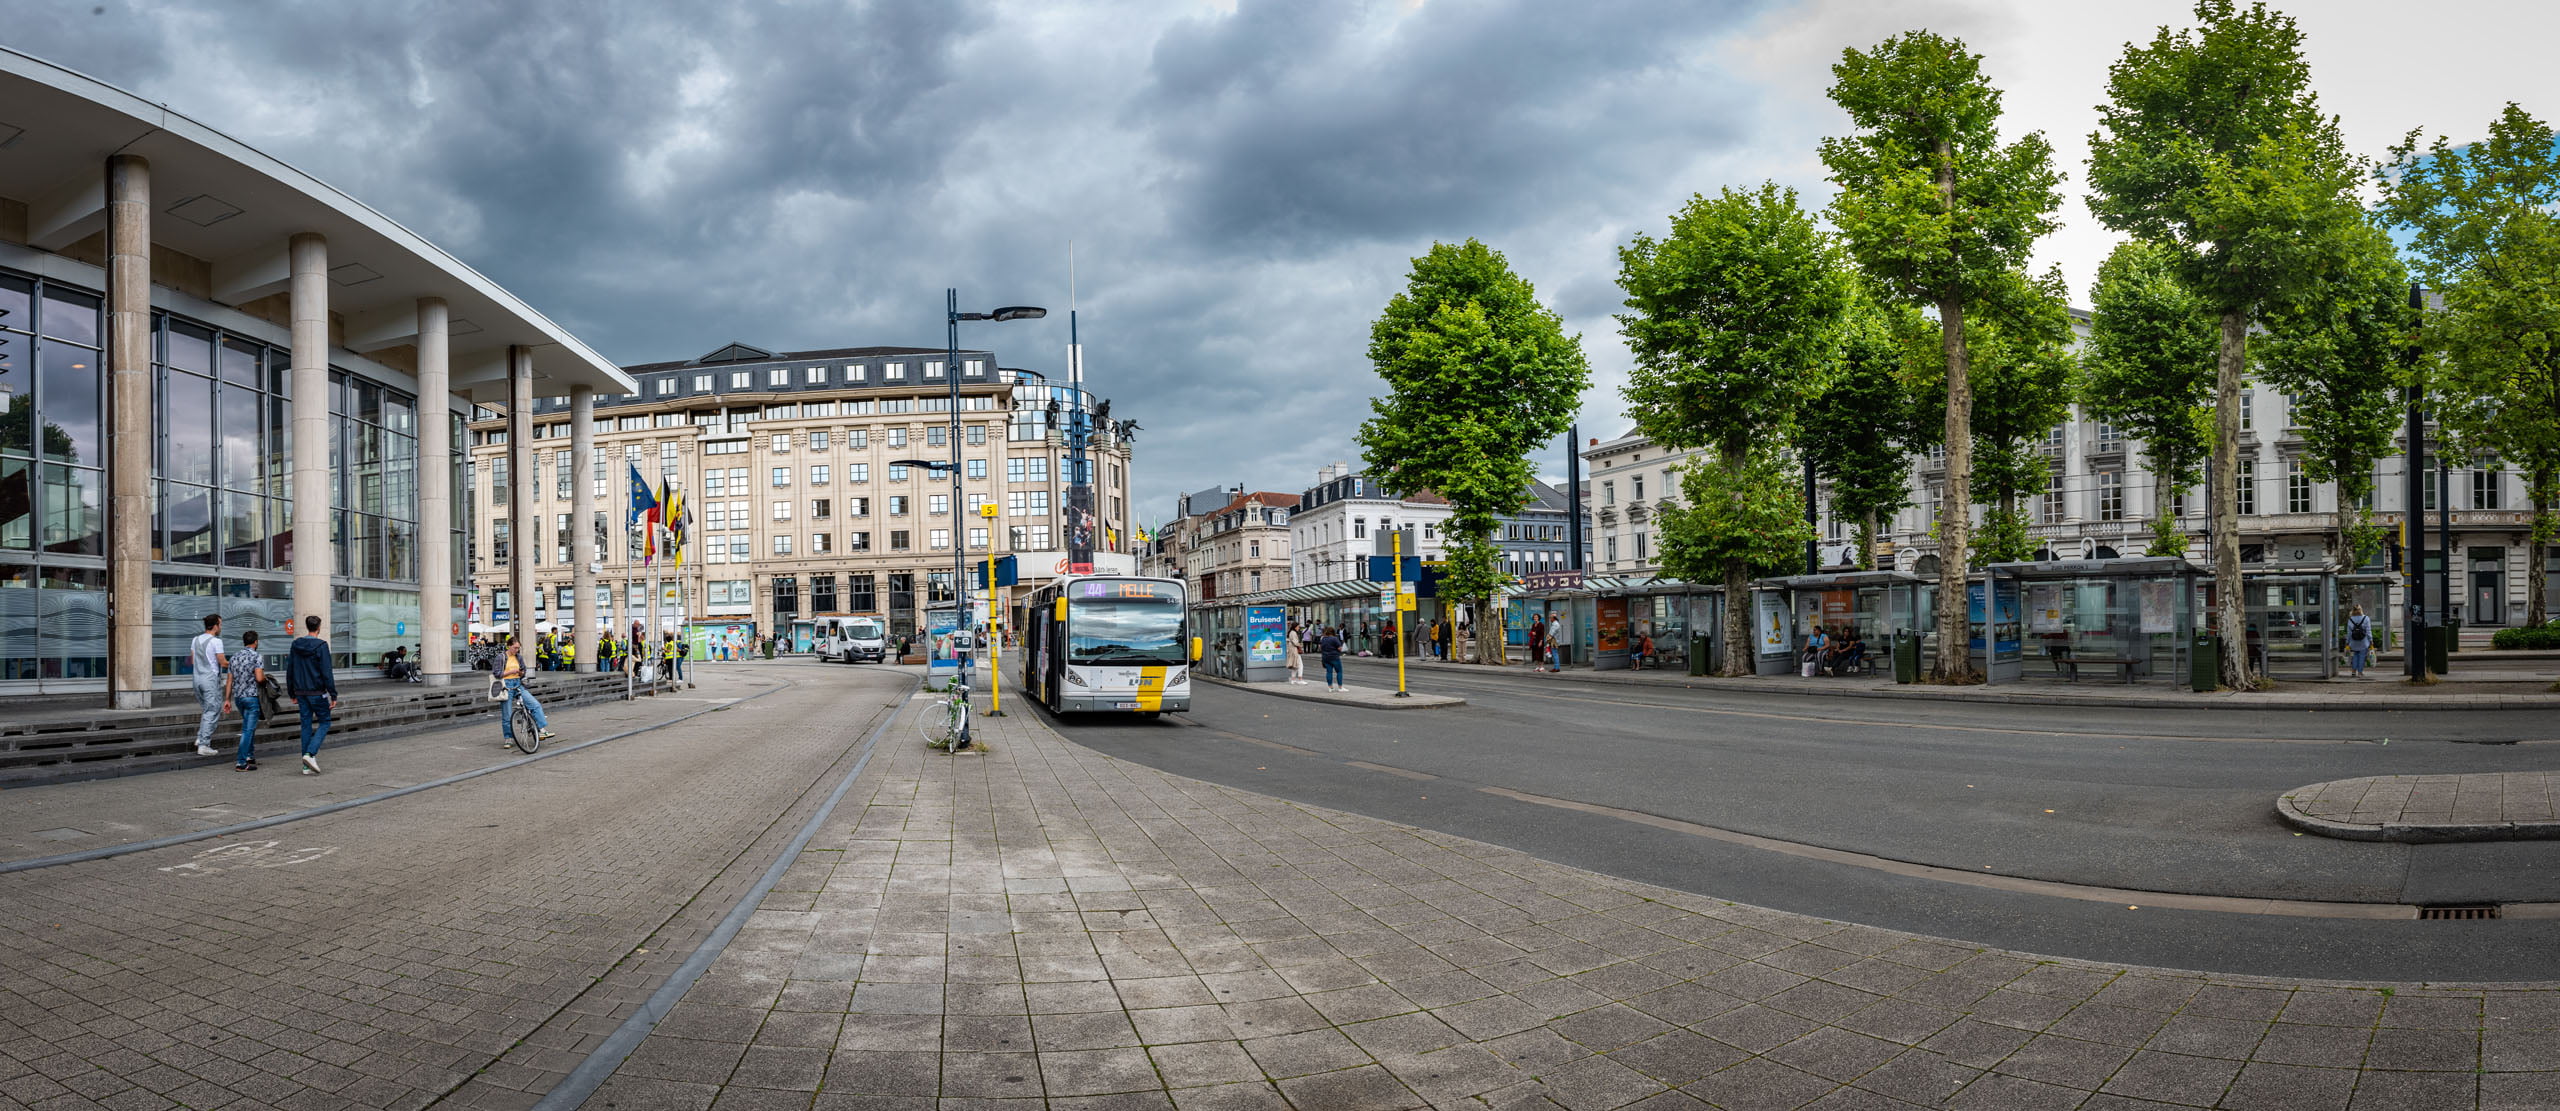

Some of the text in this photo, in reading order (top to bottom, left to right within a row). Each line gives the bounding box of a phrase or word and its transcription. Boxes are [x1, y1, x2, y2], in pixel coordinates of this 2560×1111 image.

[987, 506, 993, 515] 5
[1088, 584, 1102, 595] 44
[1119, 584, 1154, 597] MELLE
